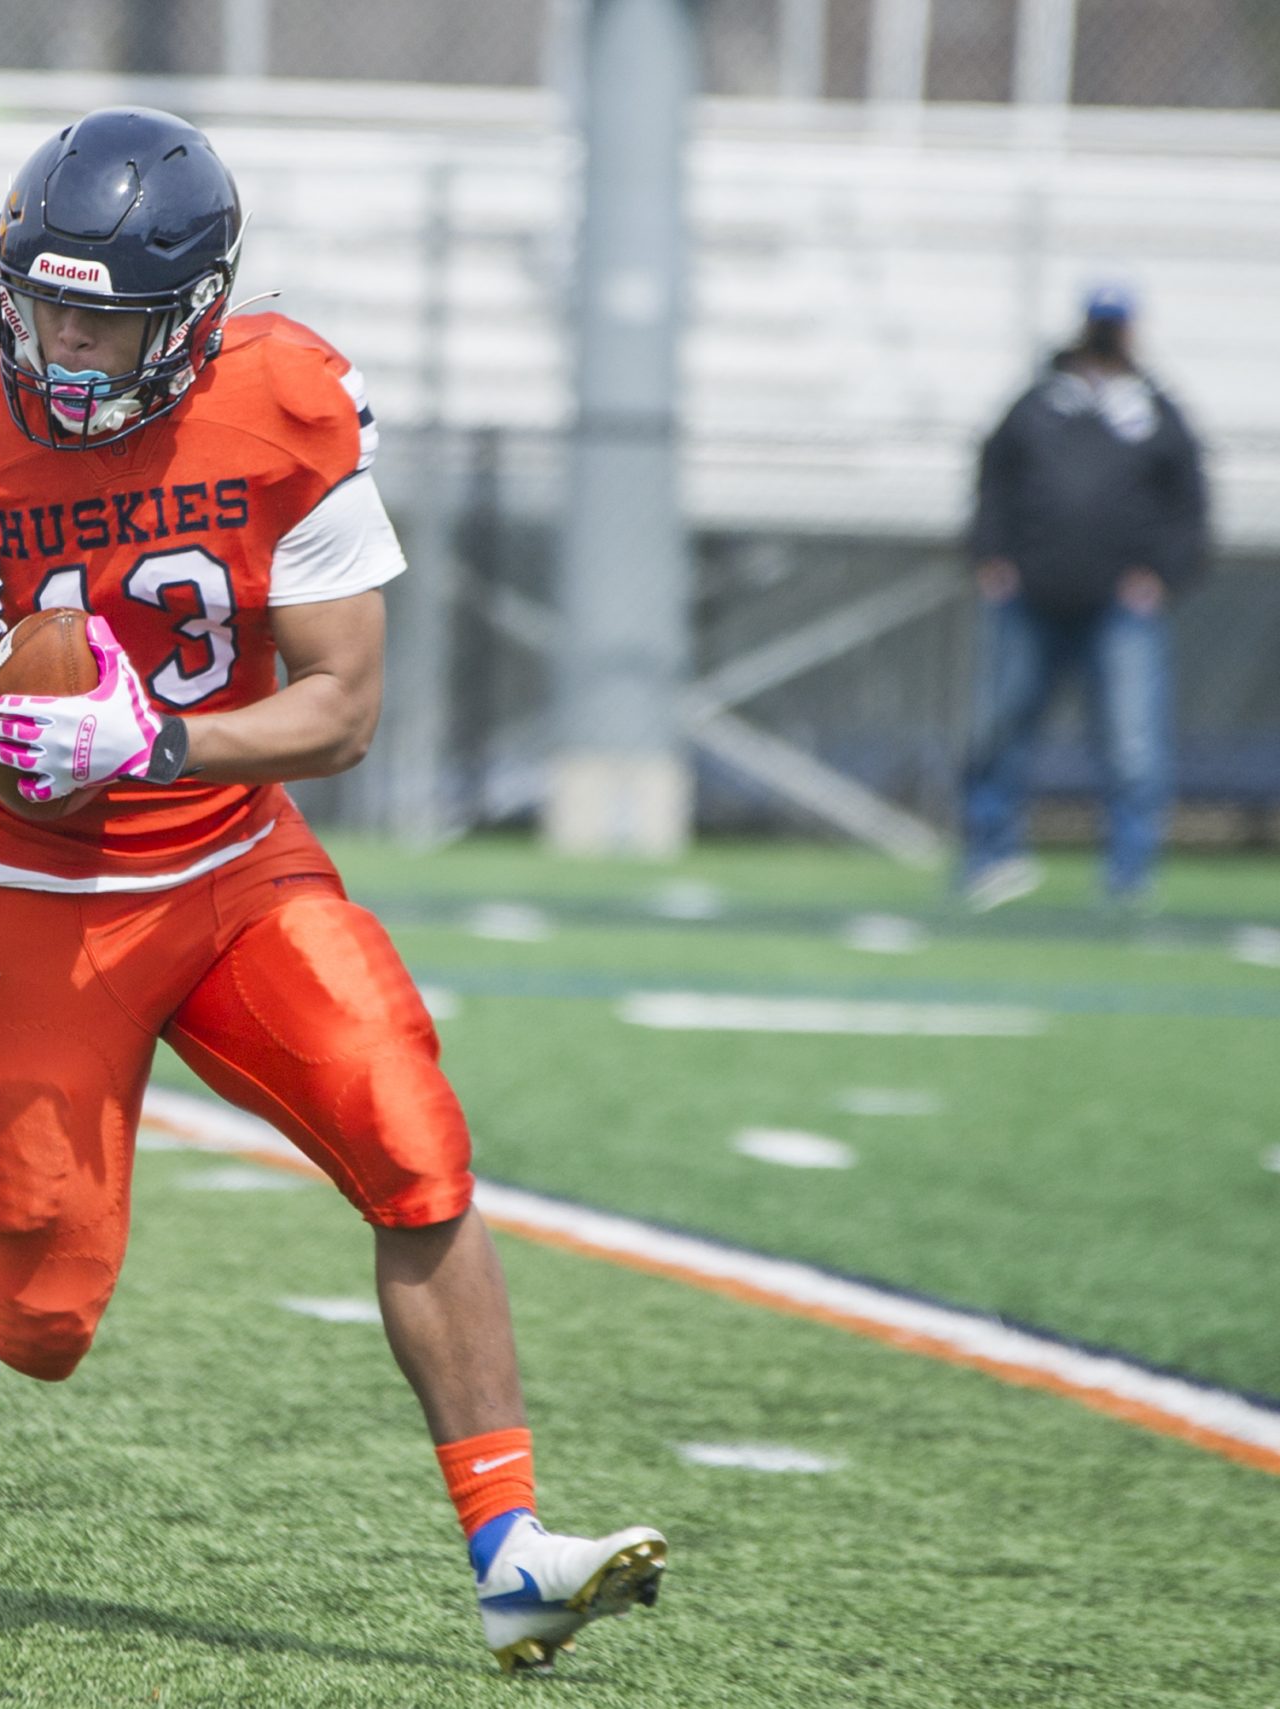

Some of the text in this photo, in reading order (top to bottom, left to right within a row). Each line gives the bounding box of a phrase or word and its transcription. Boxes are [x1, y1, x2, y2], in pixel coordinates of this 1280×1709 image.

[39, 259, 100, 282] Riddell
[0, 291, 30, 342] Riddell
[75, 721, 93, 778] BATTLE
